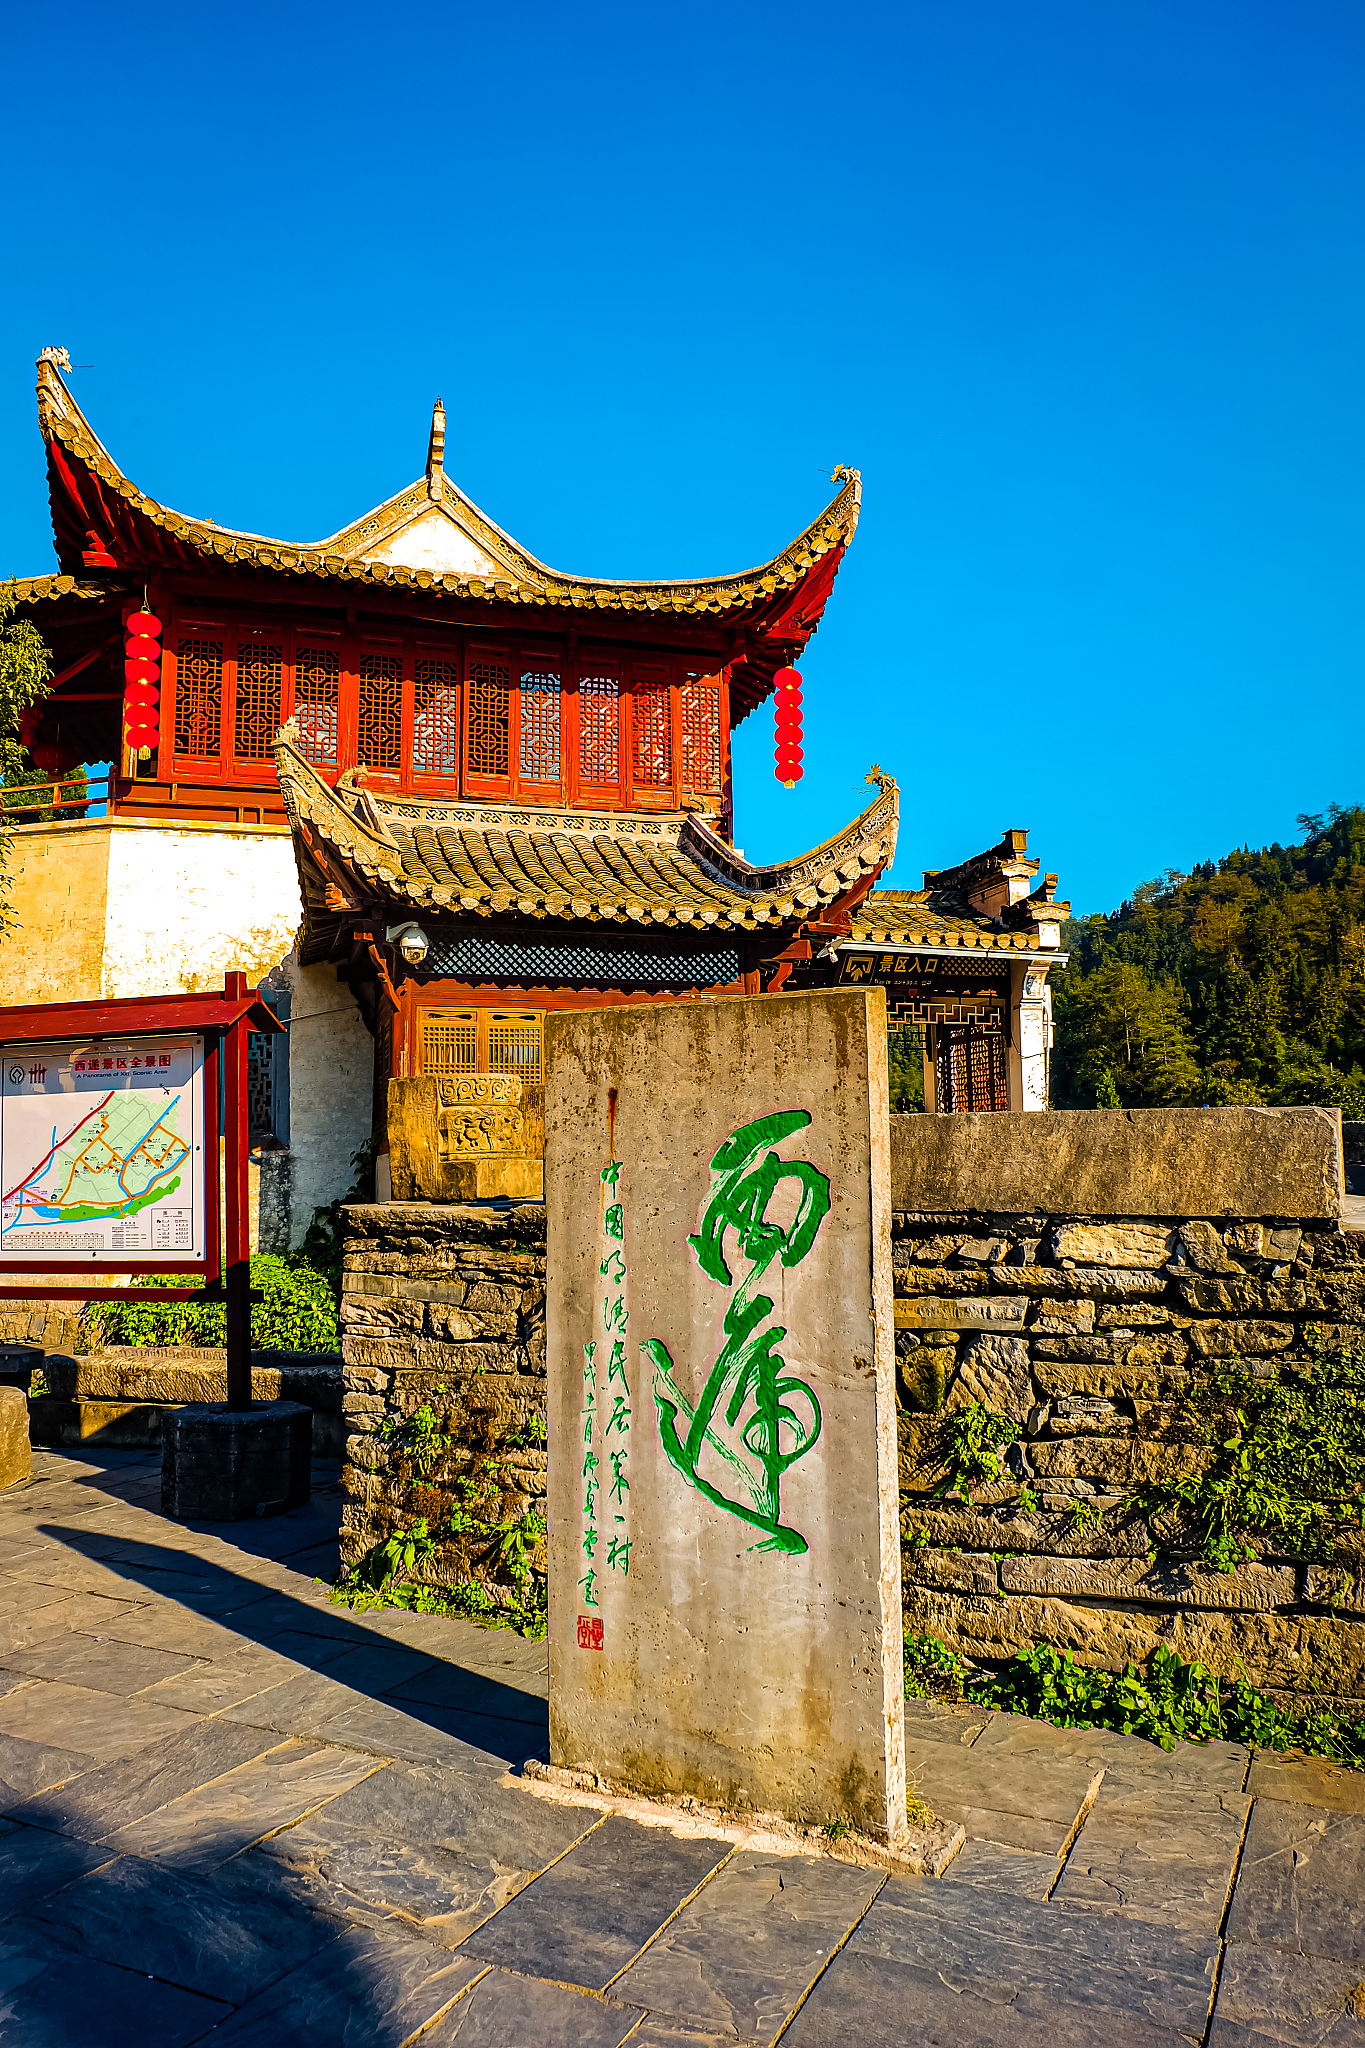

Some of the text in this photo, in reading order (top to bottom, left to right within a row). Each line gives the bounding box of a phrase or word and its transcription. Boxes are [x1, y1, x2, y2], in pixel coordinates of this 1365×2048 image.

[879, 955, 938, 973] 景区入口
[74, 1054, 172, 1071] 西递景区全景图
